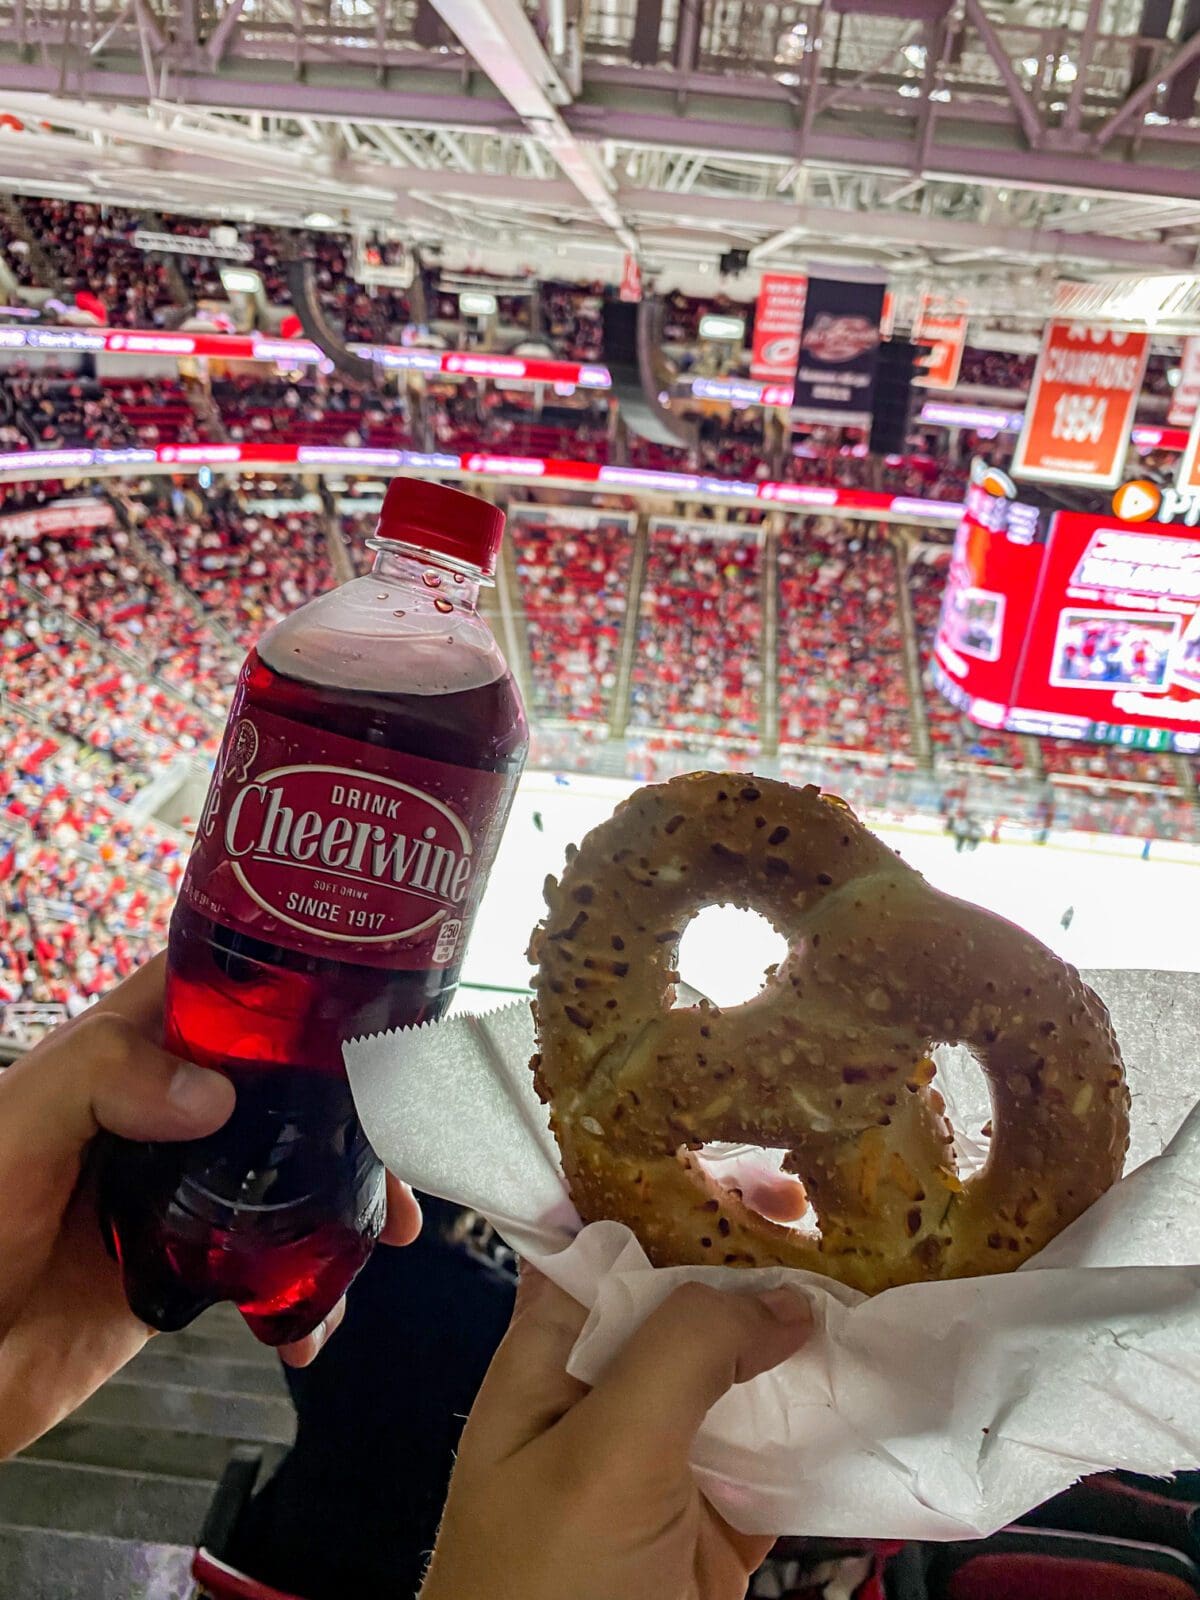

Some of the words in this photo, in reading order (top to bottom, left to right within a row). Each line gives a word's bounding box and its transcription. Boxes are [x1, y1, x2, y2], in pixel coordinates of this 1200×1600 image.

[331, 785, 402, 819] DRINK
[225, 784, 472, 903] Cheerwine
[313, 880, 337, 893] SOFT
[340, 887, 369, 900] DRINK
[287, 892, 341, 922] SINCE
[348, 909, 386, 930] 1917
[440, 923, 460, 939] 250
